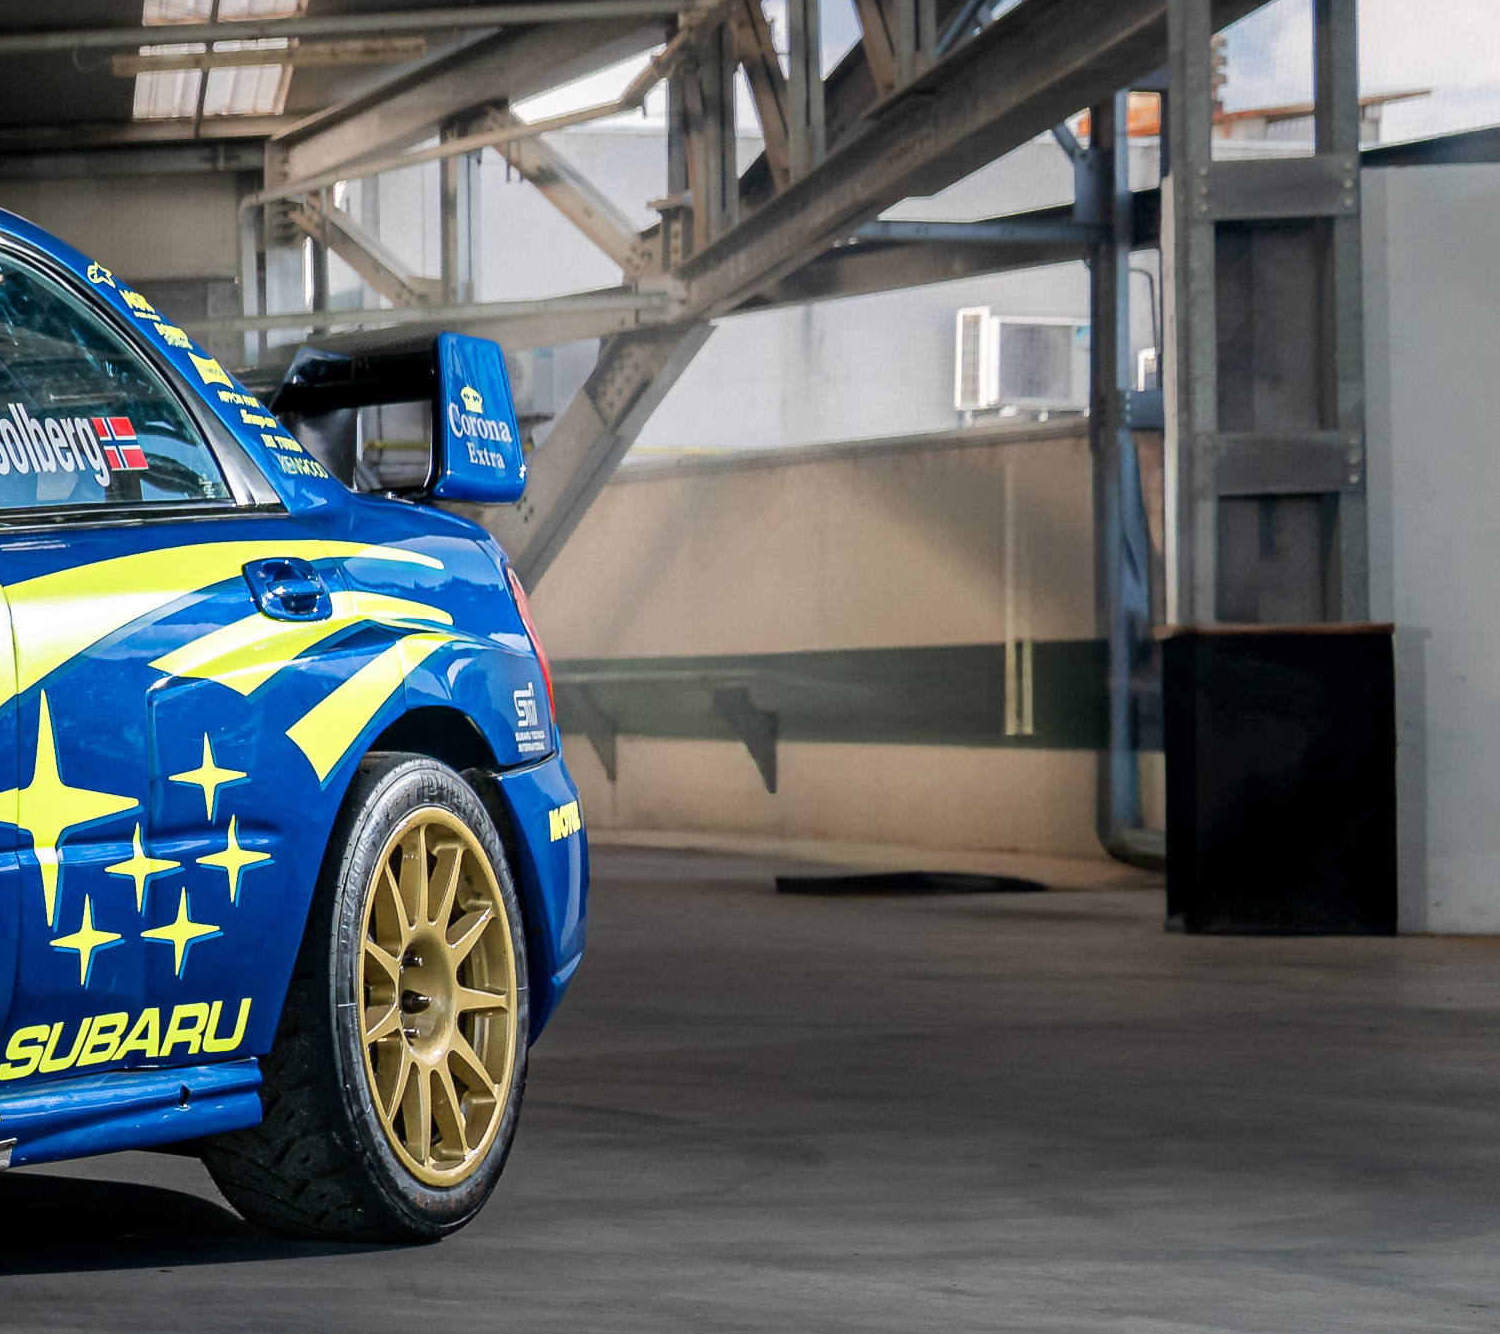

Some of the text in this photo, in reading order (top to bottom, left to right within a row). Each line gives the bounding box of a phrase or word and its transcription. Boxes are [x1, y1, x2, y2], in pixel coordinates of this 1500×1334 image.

[448, 402, 513, 443] Corona
[276, 454, 330, 479] KENWOOD
[466, 441, 506, 469] Extra
[549, 799, 583, 843] MOTUL
